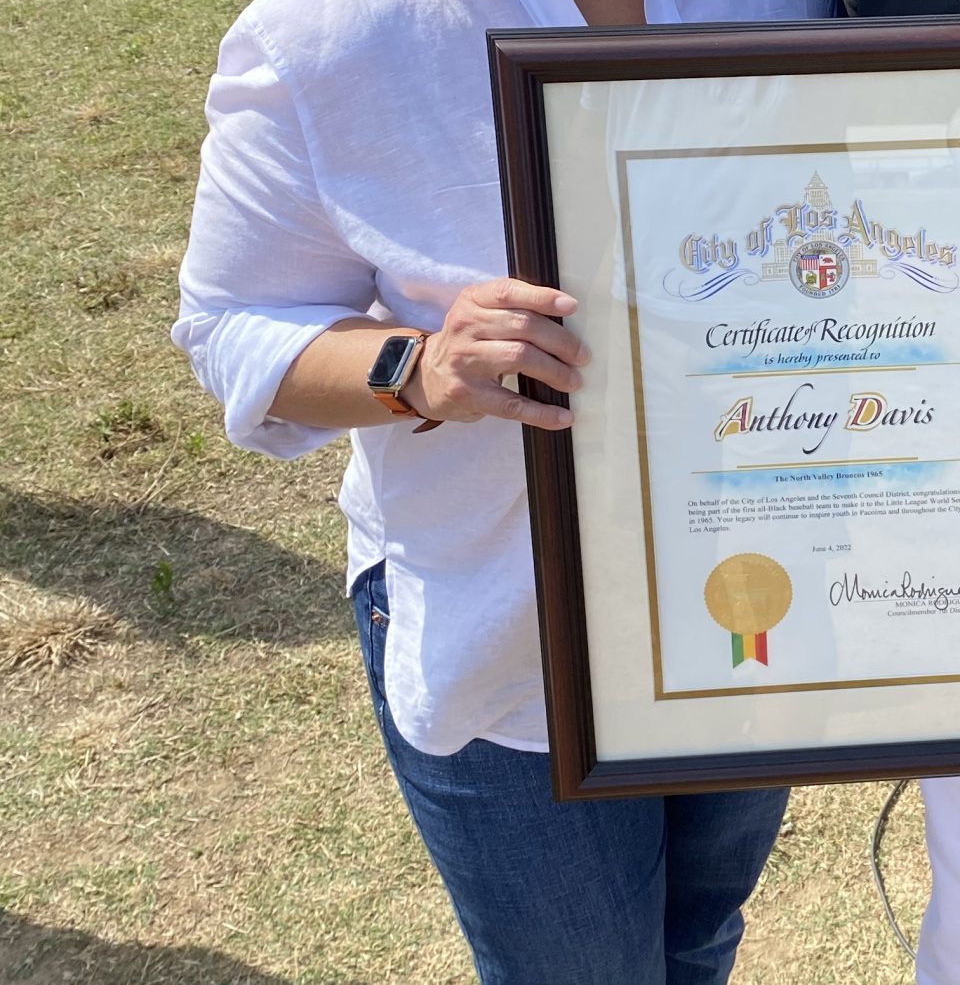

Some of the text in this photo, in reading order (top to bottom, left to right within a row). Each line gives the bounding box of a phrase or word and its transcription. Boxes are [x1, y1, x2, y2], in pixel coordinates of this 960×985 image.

[679, 199, 958, 274] City of Los Angeles
[705, 315, 936, 358] Certificate of Recognition
[764, 347, 881, 368] is hereby presented to
[713, 382, 935, 455] Anthony Davis
[775, 470, 883, 483] The North Valley Broncos 1965
[689, 508, 706, 516] being
[708, 508, 720, 516] part
[788, 503, 814, 511] baseball
[905, 498, 928, 506] League
[700, 499, 720, 507] behalf
[741, 497, 755, 505] City
[780, 495, 806, 504] Angeles
[859, 491, 884, 499] Council
[886, 490, 911, 498] District,
[913, 489, 960, 498] congratulations
[735, 515, 755, 523] legacy
[831, 510, 850, 518] youth
[860, 508, 887, 516] Pacoima
[901, 507, 935, 515] throughout
[948, 505, 960, 513] City
[703, 525, 730, 534] Angeles.
[812, 545, 827, 553] June
[887, 609, 936, 617] Councilmember
[895, 600, 926, 608] MONICA
